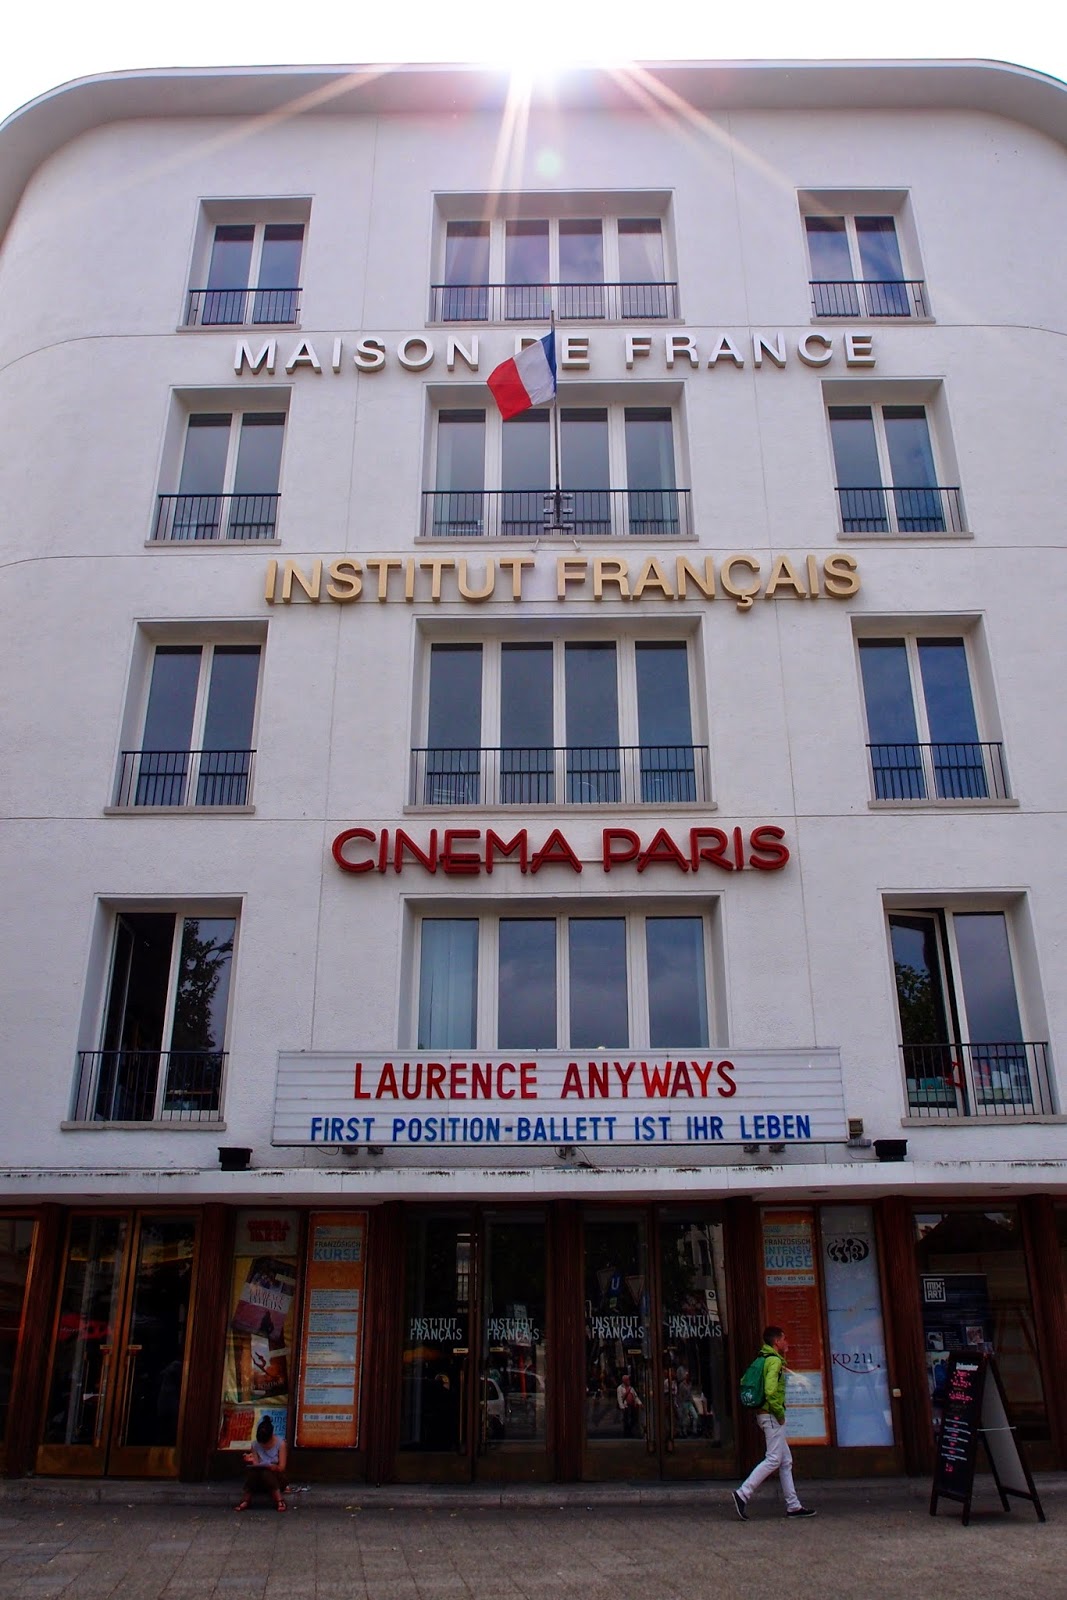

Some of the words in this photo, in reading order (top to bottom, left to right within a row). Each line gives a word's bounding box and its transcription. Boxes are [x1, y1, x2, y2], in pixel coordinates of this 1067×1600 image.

[234, 335, 479, 374] MAISON
[625, 333, 877, 369] FRANCE
[265, 556, 535, 603] INSTITUT
[556, 553, 861, 611] FRANÇAIS
[332, 826, 582, 875] CINEMA
[602, 824, 790, 874] PARIS
[354, 1062, 538, 1100] LAURENCE
[561, 1060, 737, 1099] ANYWAYS
[310, 1117, 375, 1142] FIRST
[634, 1116, 671, 1141] IST
[686, 1115, 723, 1140] IHR
[740, 1114, 811, 1139] LEBEN
[314, 1248, 360, 1261] KURSE
[766, 1256, 813, 1268] KURSE
[928, 1290, 943, 1299] ART
[410, 1317, 457, 1330] INSTITUT
[487, 1317, 534, 1330] INSTITUT
[592, 1315, 639, 1328] INSTITUT
[832, 1353, 850, 1364] KD
